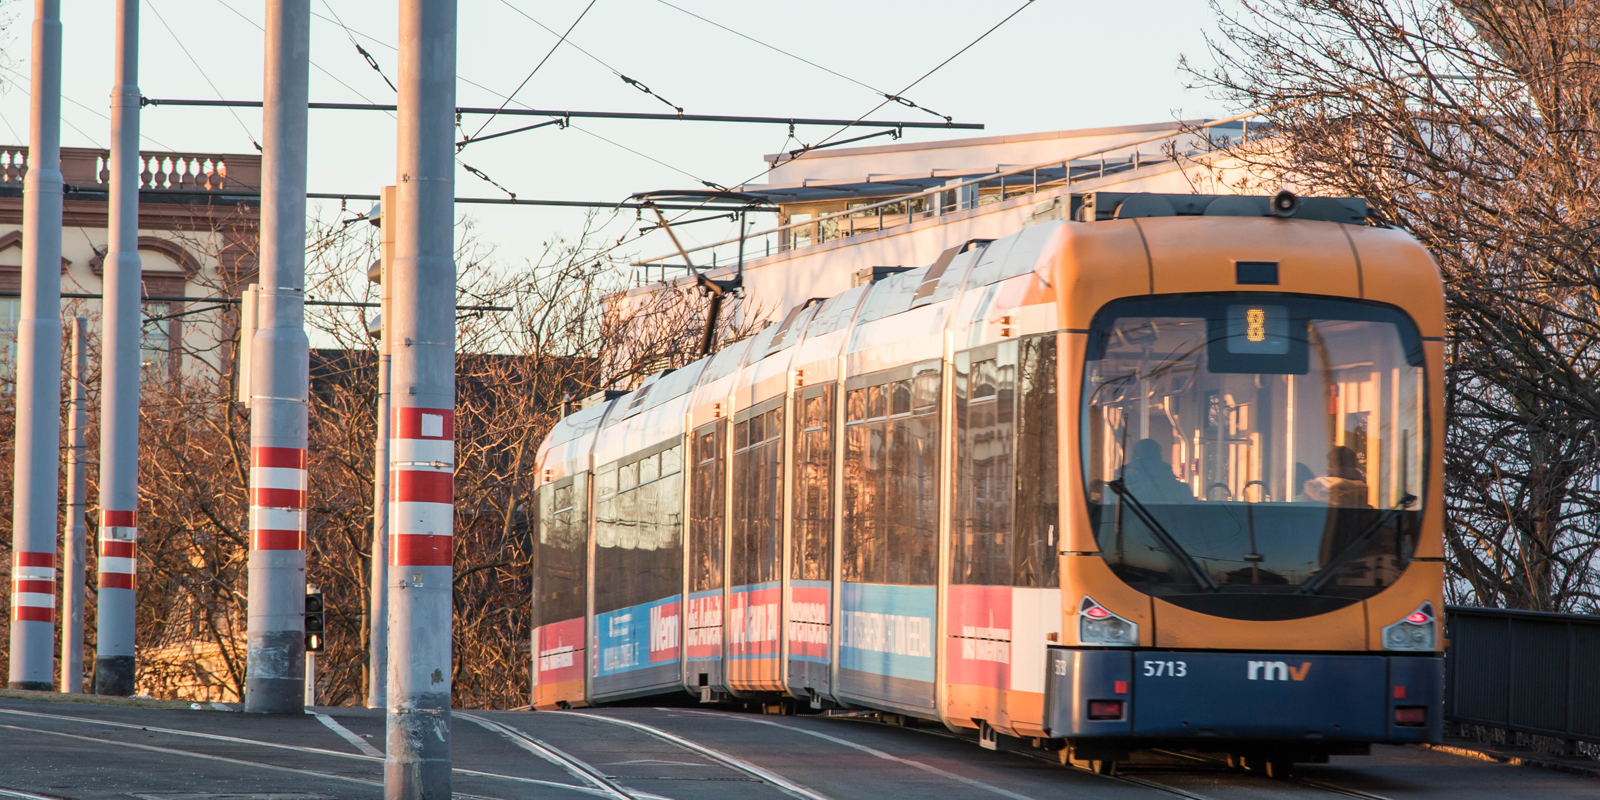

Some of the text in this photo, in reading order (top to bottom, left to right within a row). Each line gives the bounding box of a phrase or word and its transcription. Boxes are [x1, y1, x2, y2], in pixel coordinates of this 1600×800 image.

[1247, 309, 1265, 342] 8
[650, 605, 679, 652] Wenn
[1143, 660, 1187, 677] 5713
[1247, 660, 1312, 682] rnv
